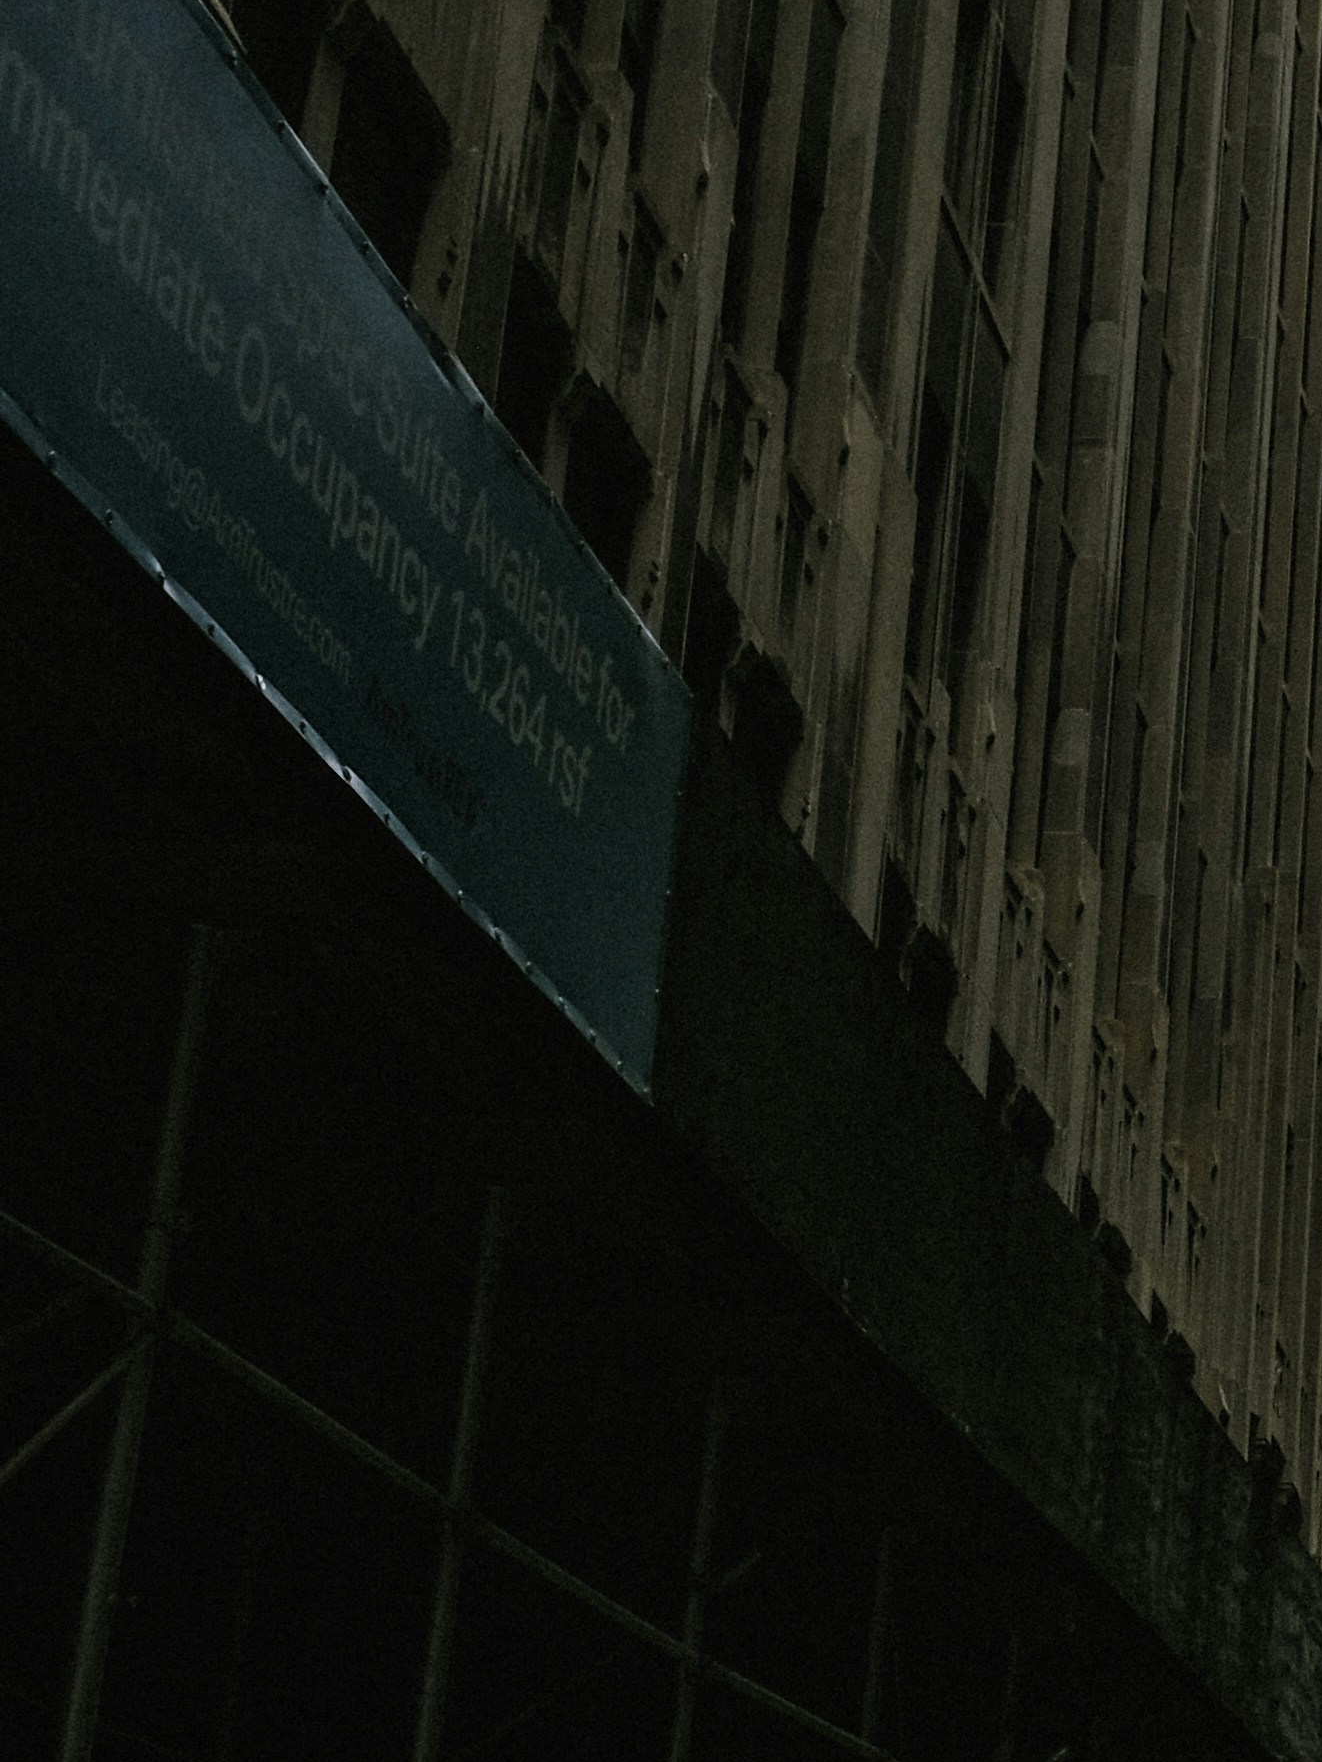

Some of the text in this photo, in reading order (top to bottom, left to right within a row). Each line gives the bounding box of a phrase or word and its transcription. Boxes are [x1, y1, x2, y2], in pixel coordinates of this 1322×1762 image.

[235, 323, 441, 652] Occupancy
[449, 590, 548, 767] 13,264
[547, 729, 593, 817] rsf
[377, 363, 461, 534] Suite
[464, 487, 594, 706] Available
[597, 652, 636, 756] for
